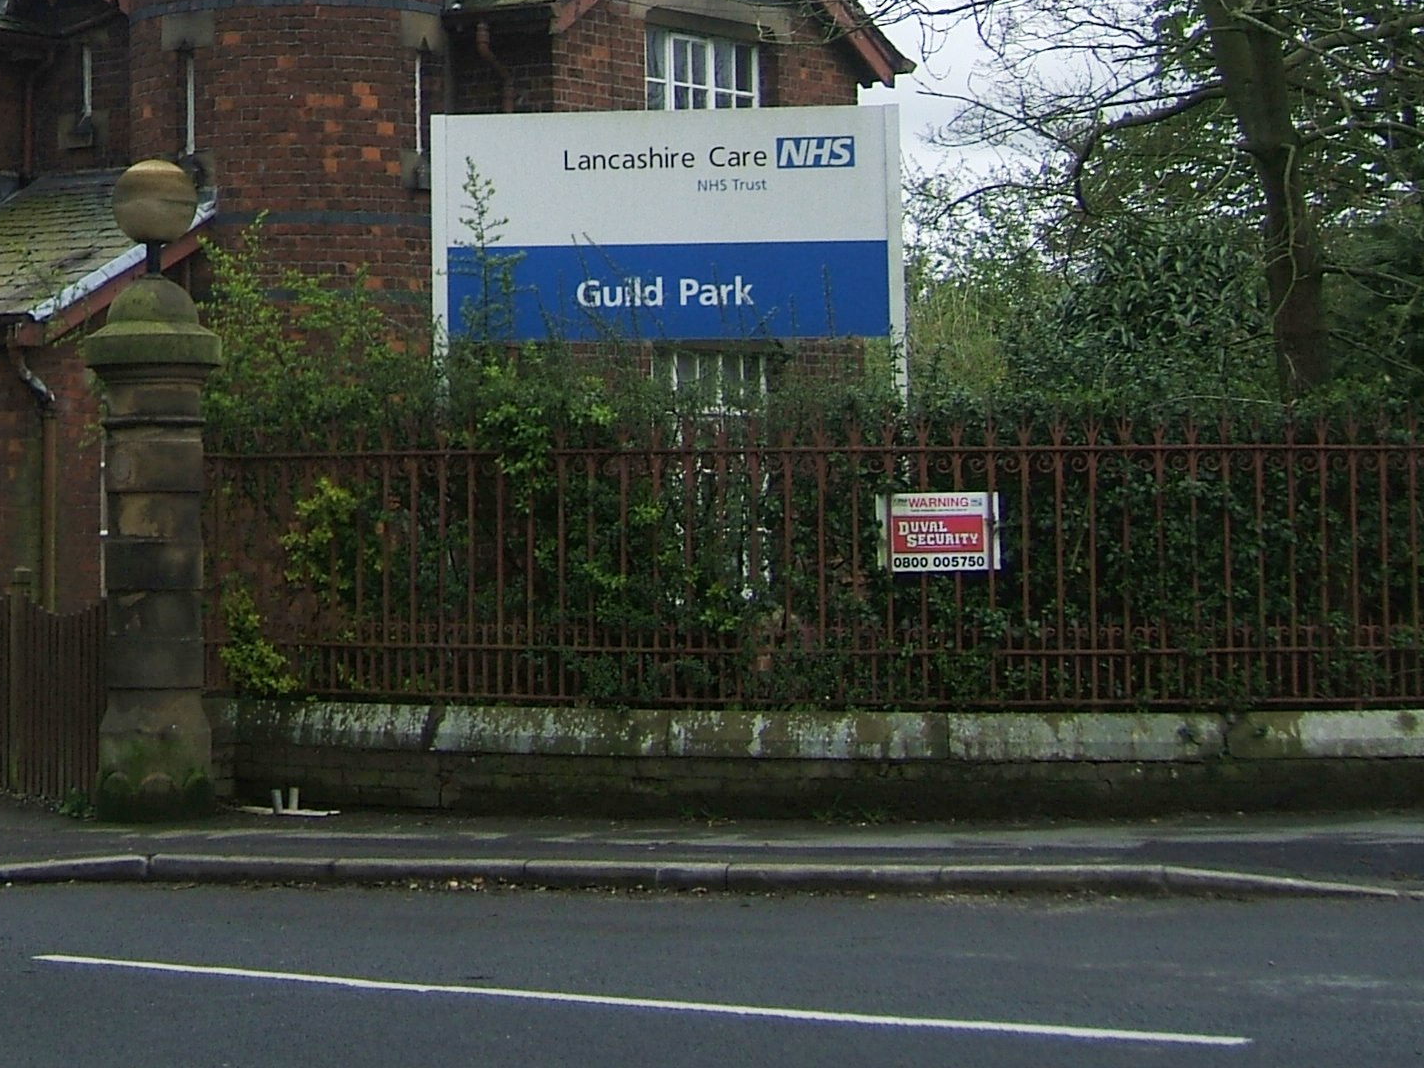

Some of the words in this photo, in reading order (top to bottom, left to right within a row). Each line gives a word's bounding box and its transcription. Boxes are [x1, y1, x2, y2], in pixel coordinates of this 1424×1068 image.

[563, 146, 695, 171] Lancashire
[708, 146, 767, 168] Care
[778, 137, 853, 167] NHS
[697, 178, 727, 192] NHS
[732, 178, 767, 191] Trust
[576, 277, 663, 308] Guild
[679, 275, 754, 307] Park
[908, 497, 969, 508] WARNING
[898, 521, 948, 535] DUVAL
[906, 533, 978, 548] SECURITY
[893, 557, 928, 568] 0800
[933, 556, 985, 567] 005750
